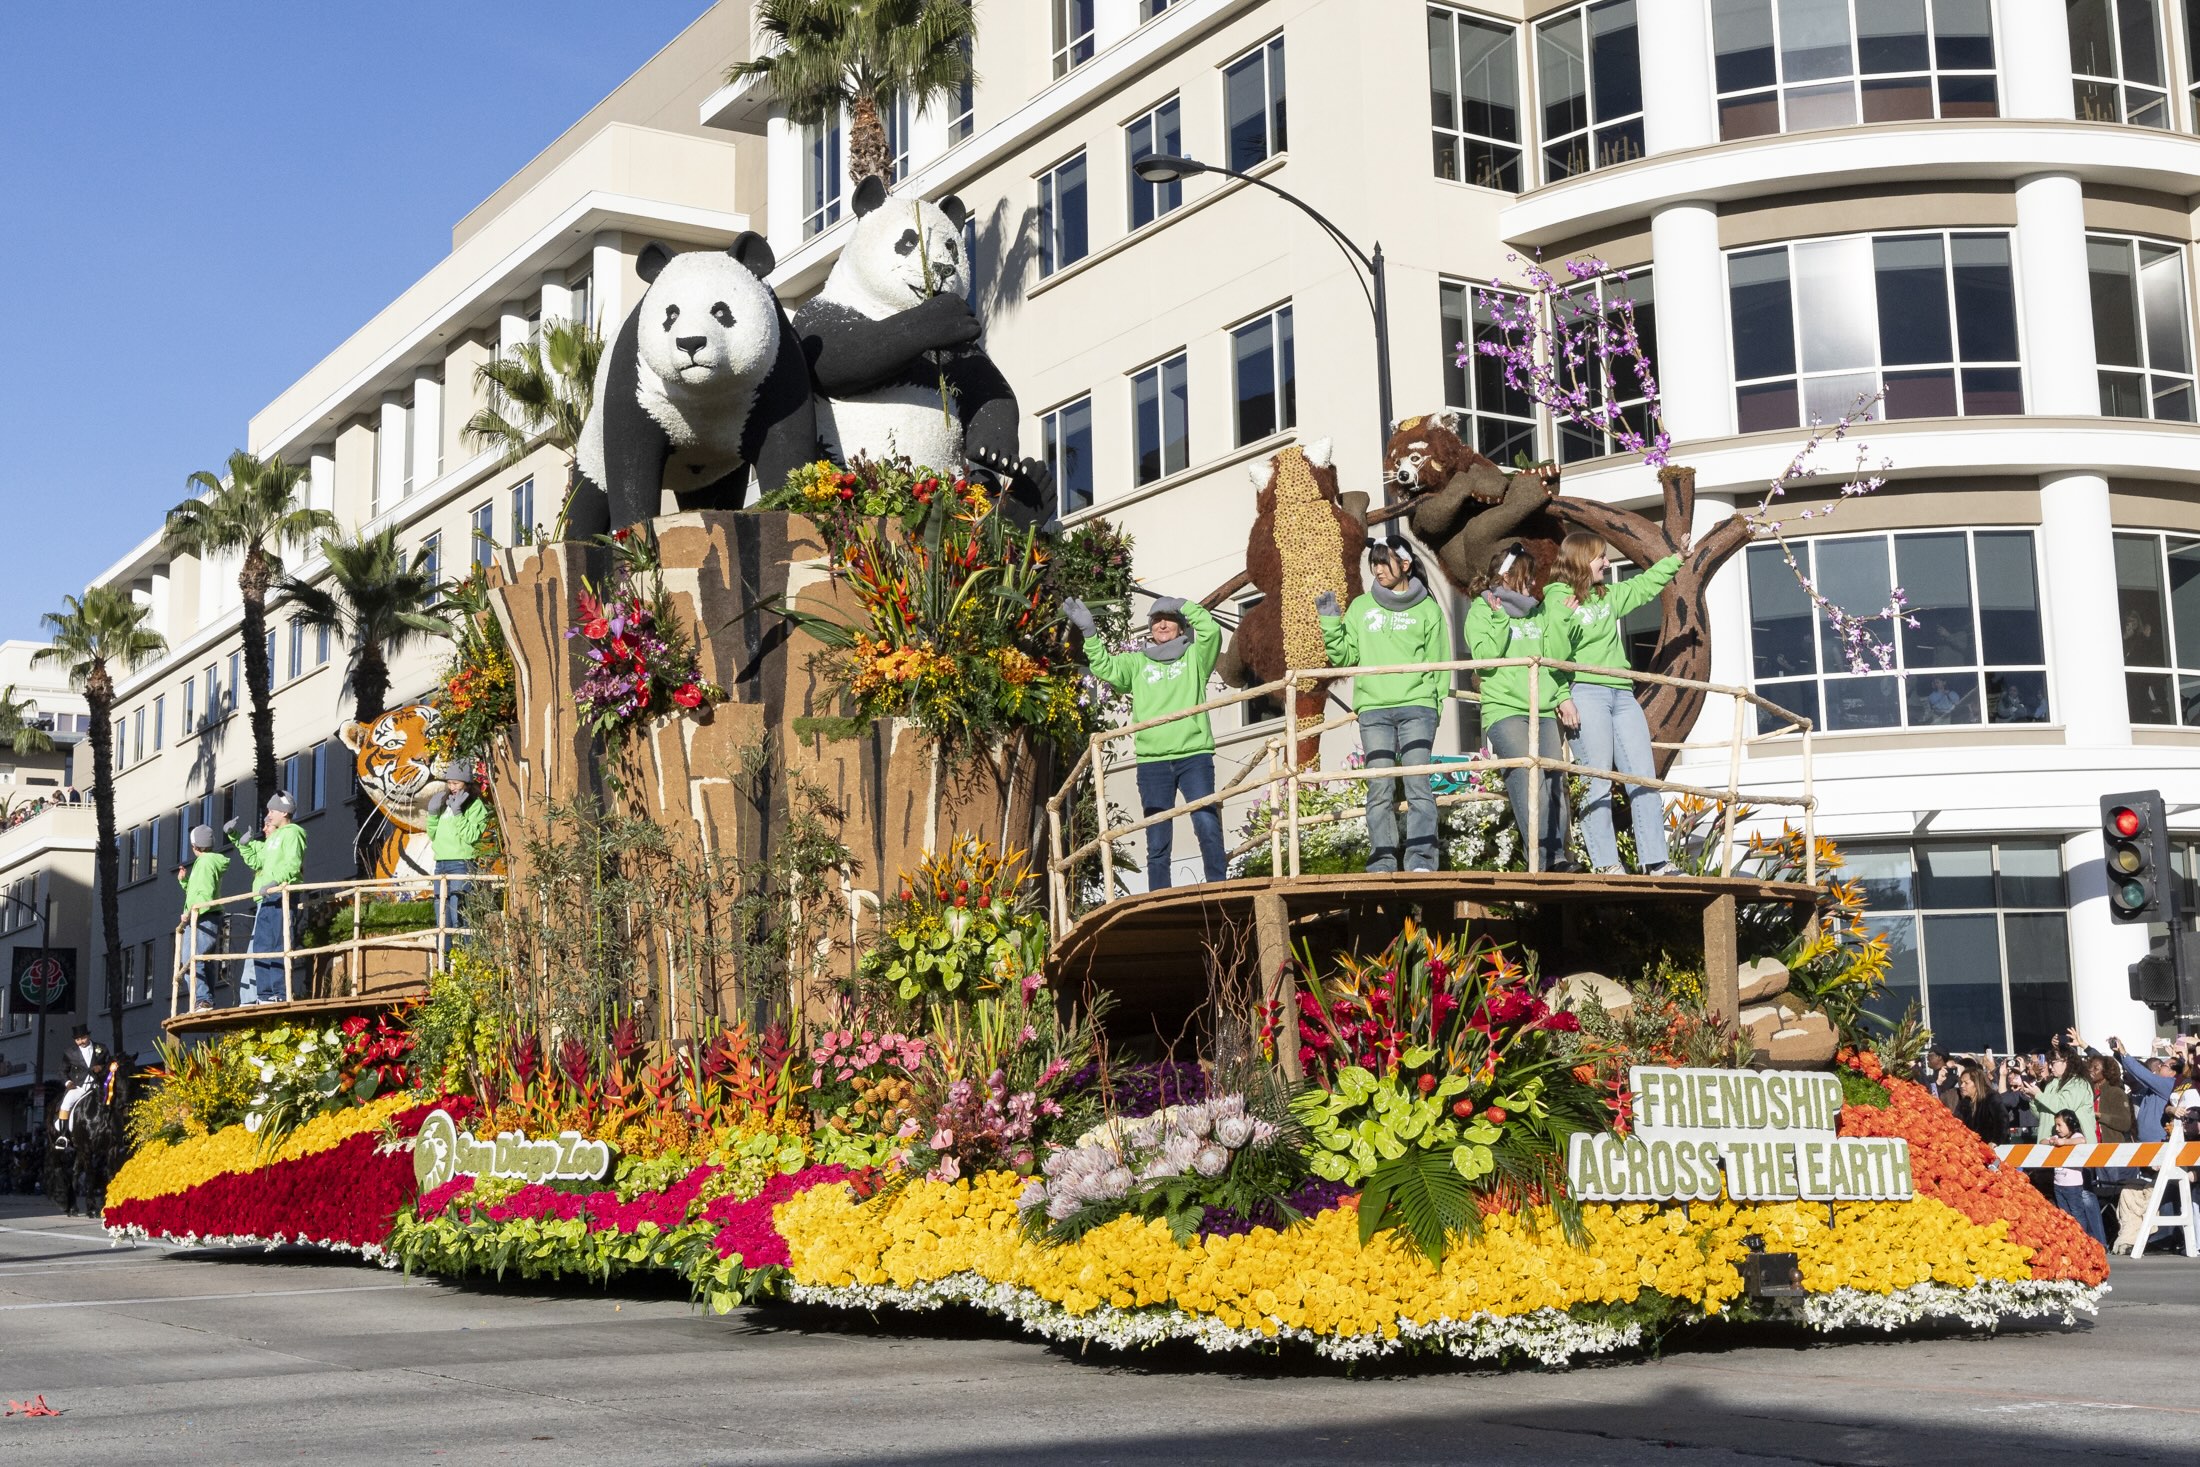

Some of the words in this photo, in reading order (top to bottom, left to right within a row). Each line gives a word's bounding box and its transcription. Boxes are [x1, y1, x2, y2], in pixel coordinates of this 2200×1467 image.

[1639, 1072, 1843, 1131] FRIENDSHIP
[454, 1137, 494, 1173] San
[495, 1135, 558, 1182] Diego
[556, 1137, 604, 1174] Zoo
[1577, 1139, 1721, 1196] ACROSS
[1727, 1142, 1797, 1196] THE
[1807, 1142, 1913, 1196] EARTH
